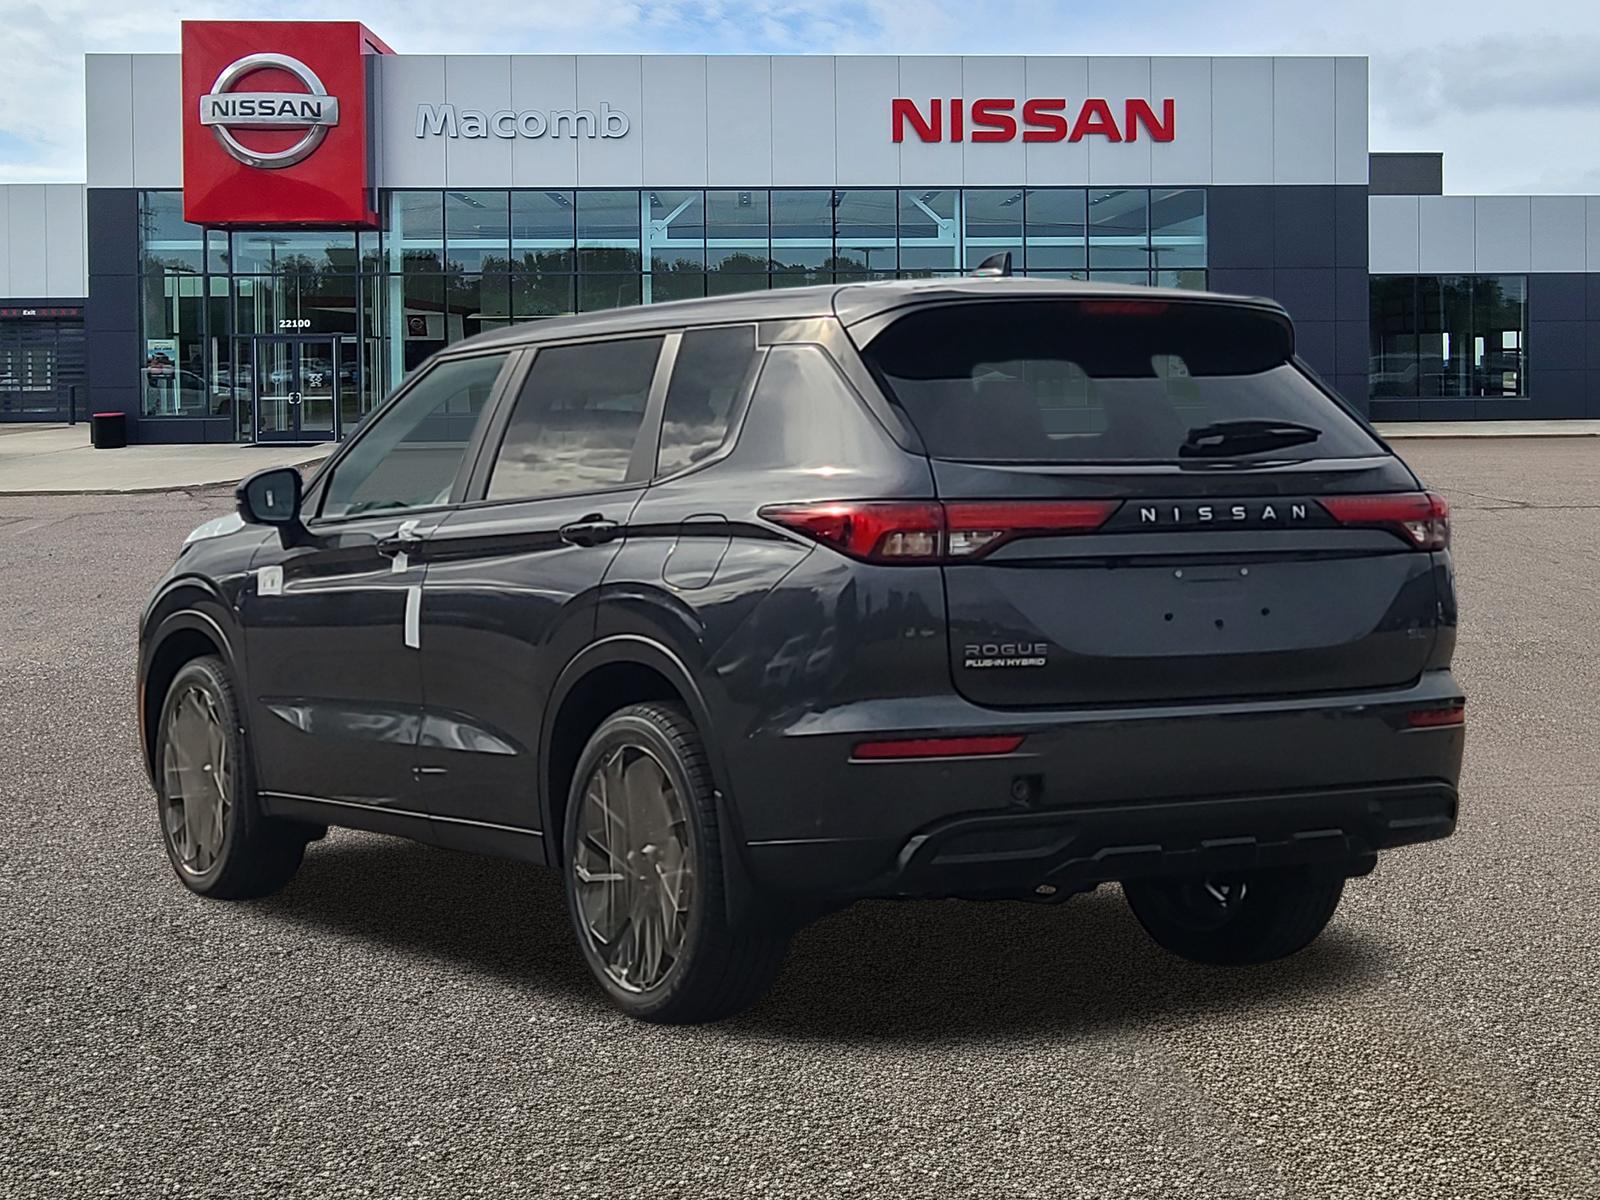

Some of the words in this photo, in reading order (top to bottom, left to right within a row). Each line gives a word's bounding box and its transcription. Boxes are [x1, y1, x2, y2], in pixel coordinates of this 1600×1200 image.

[211, 100, 322, 118] NISSAN
[415, 101, 630, 139] Macomb
[891, 98, 1176, 143] NISSAN
[279, 319, 312, 328] 22100
[1140, 504, 1306, 523] NISSAN
[964, 643, 1048, 656] ROGUE
[1006, 657, 1046, 667] HYBRID
